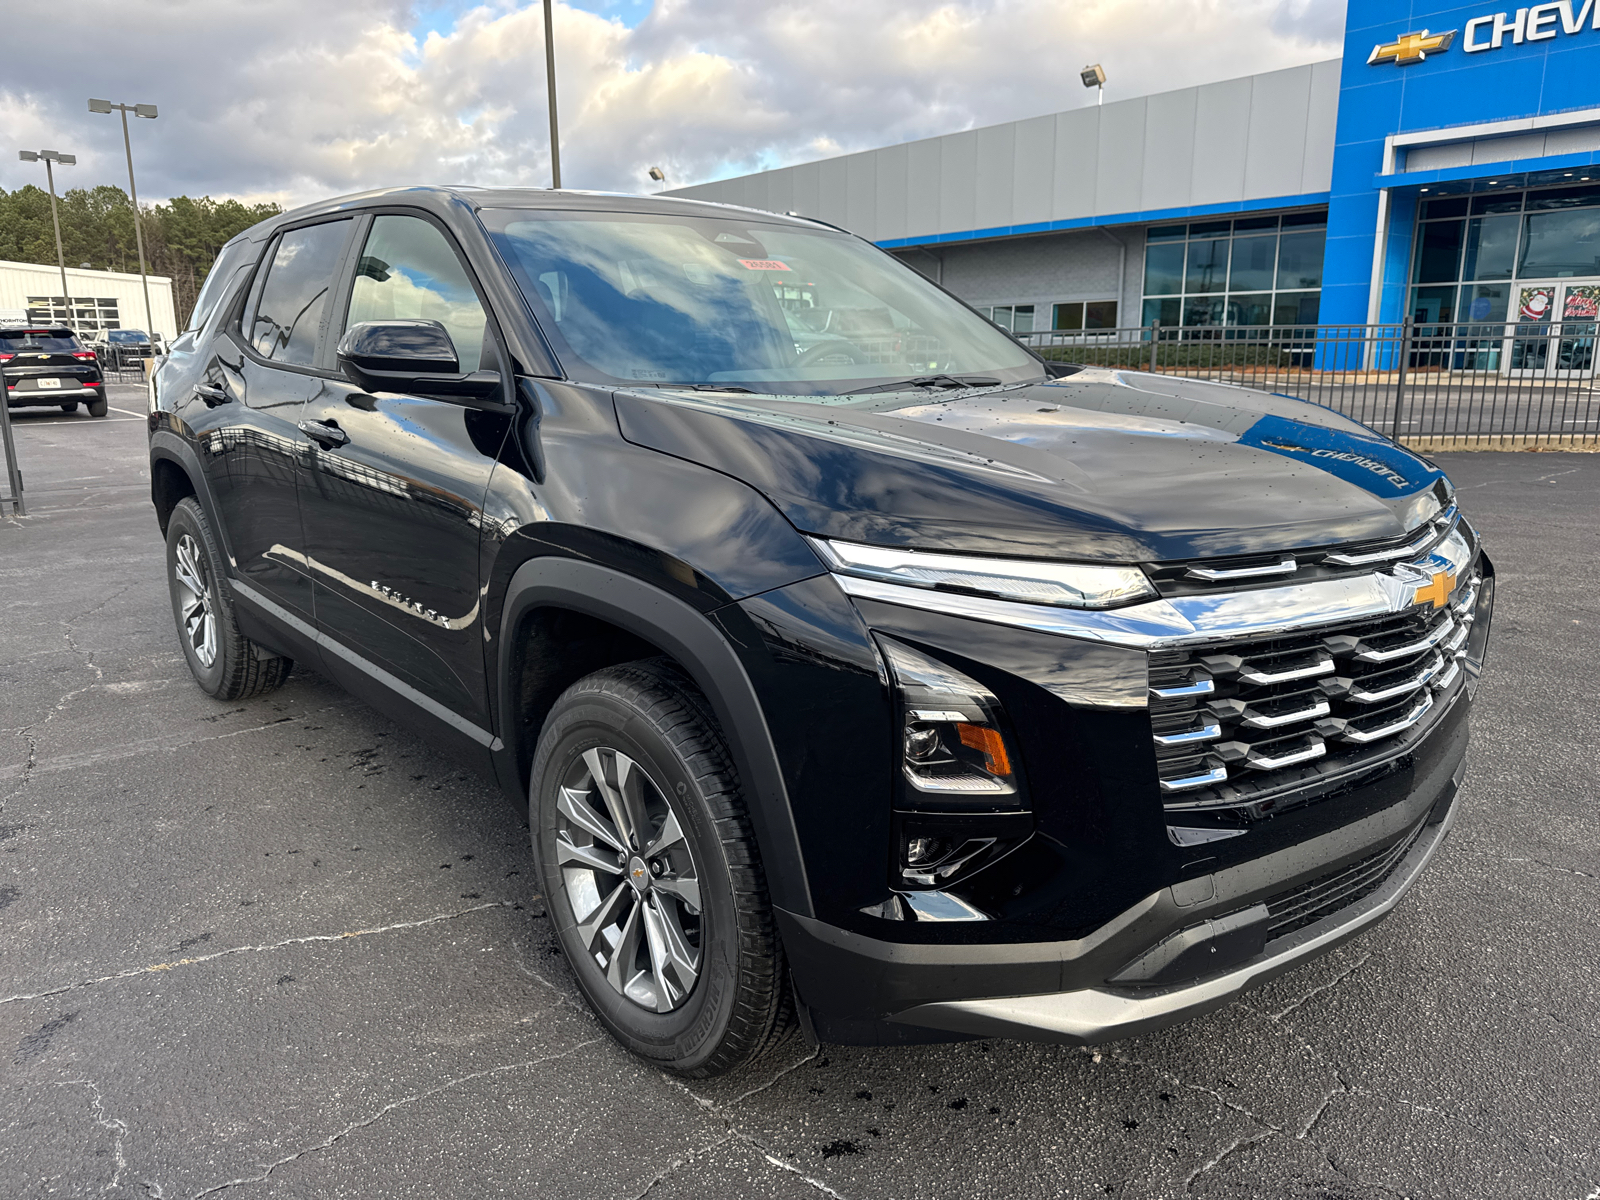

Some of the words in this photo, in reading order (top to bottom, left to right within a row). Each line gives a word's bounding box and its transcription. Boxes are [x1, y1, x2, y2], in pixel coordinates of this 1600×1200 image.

[1565, 295, 1594, 309] Merry
[371, 580, 451, 630] EQUINOX
[680, 983, 721, 1053] MICHELIN
